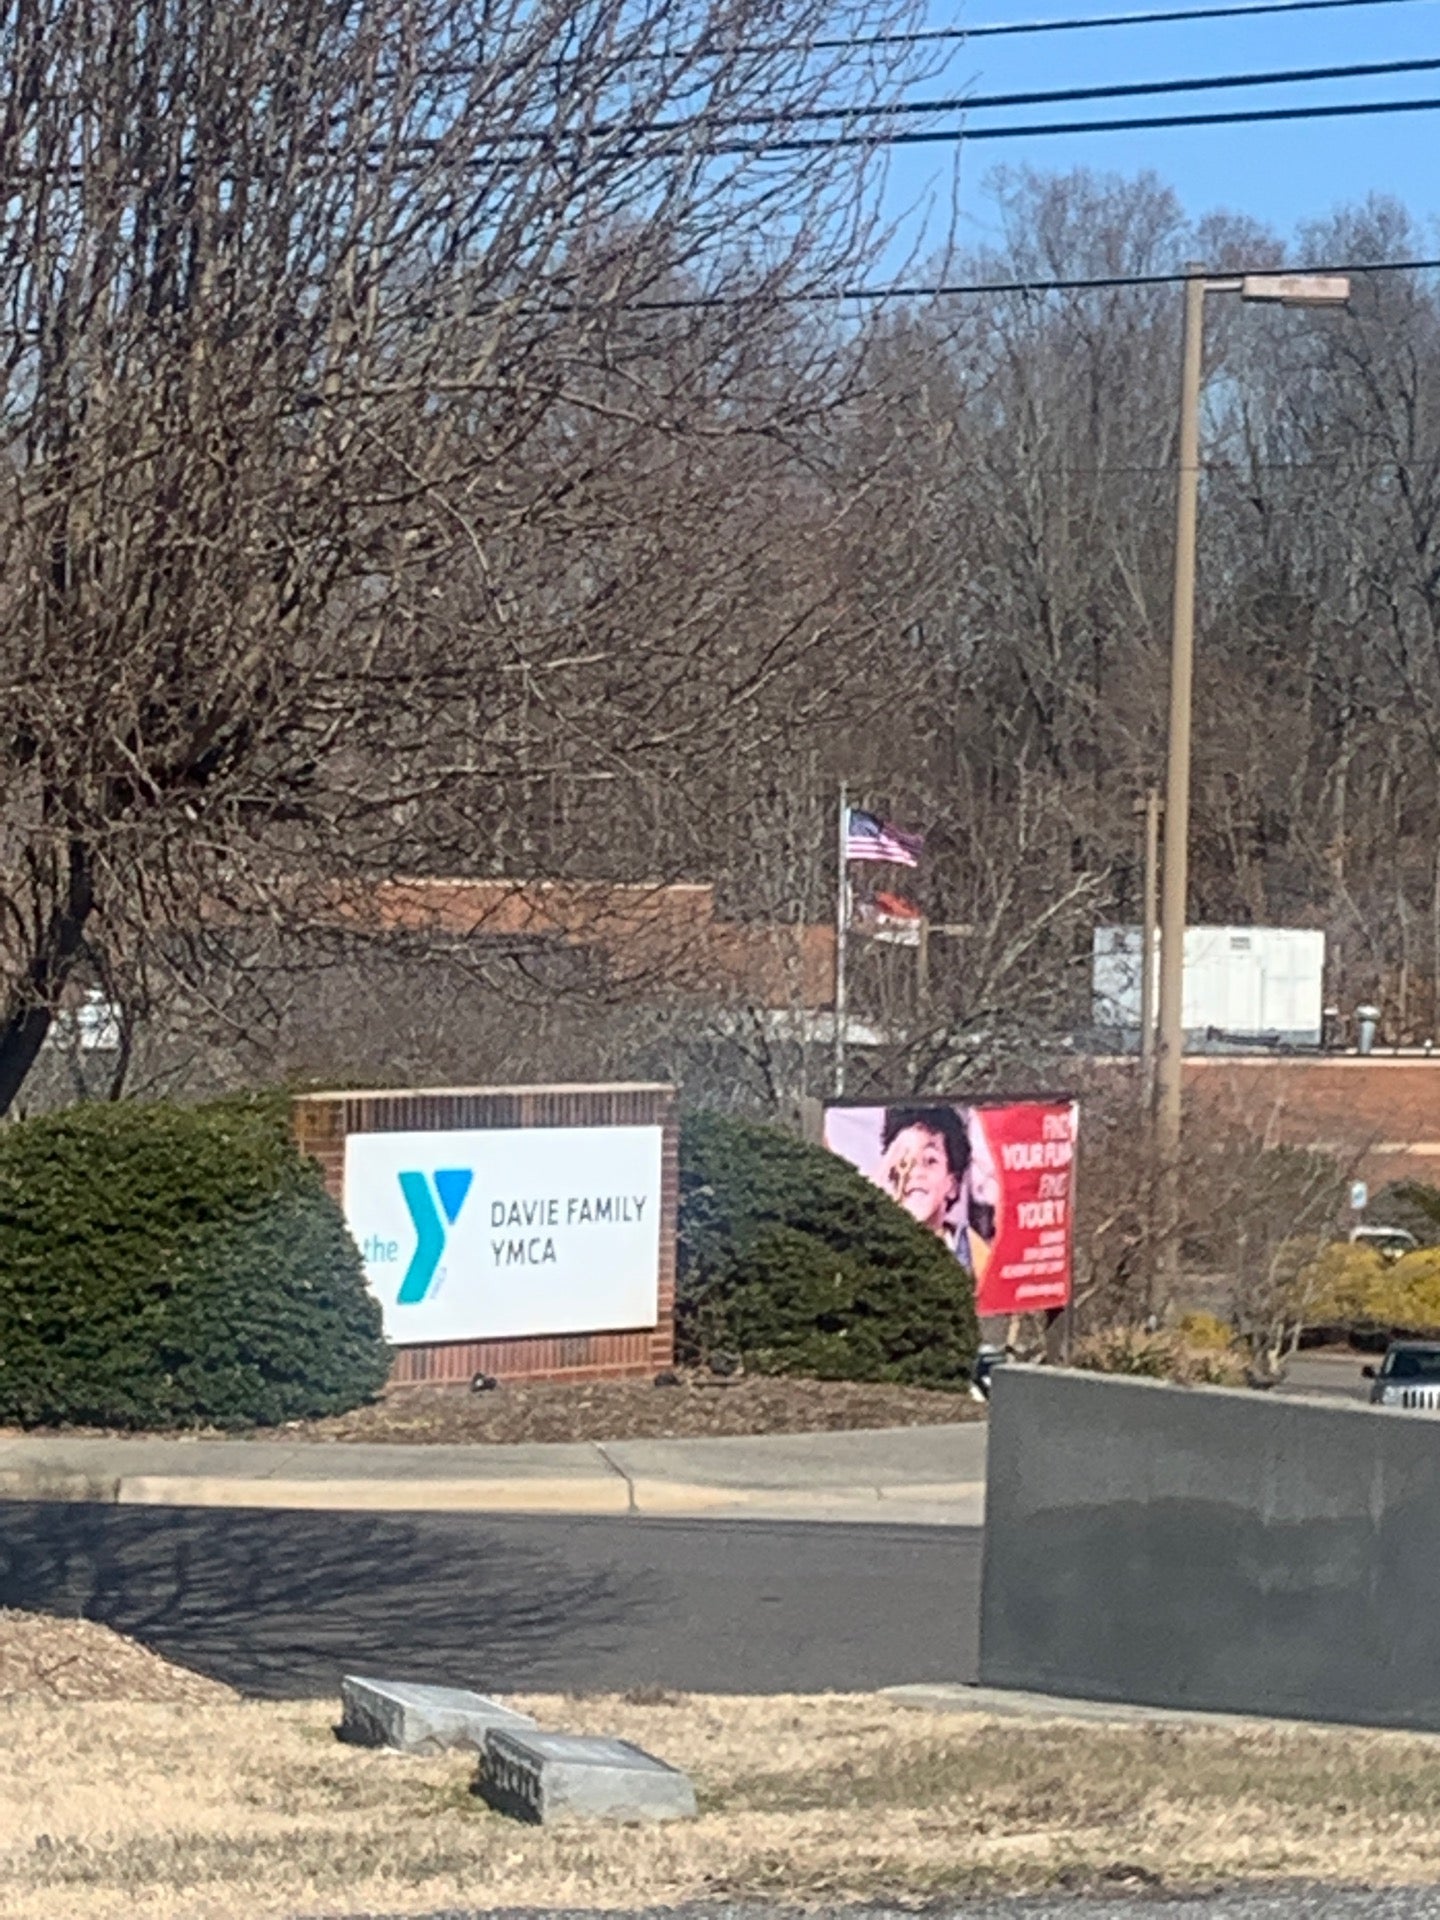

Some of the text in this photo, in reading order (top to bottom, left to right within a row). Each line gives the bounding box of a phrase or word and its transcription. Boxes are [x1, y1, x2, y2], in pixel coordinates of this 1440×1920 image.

[1001, 1143, 1043, 1170] YOUR
[491, 1196, 647, 1228] DAVIE FAMILY
[1017, 1202, 1053, 1229] YOUR
[363, 1234, 398, 1262] the
[491, 1238, 557, 1267] YMCA
